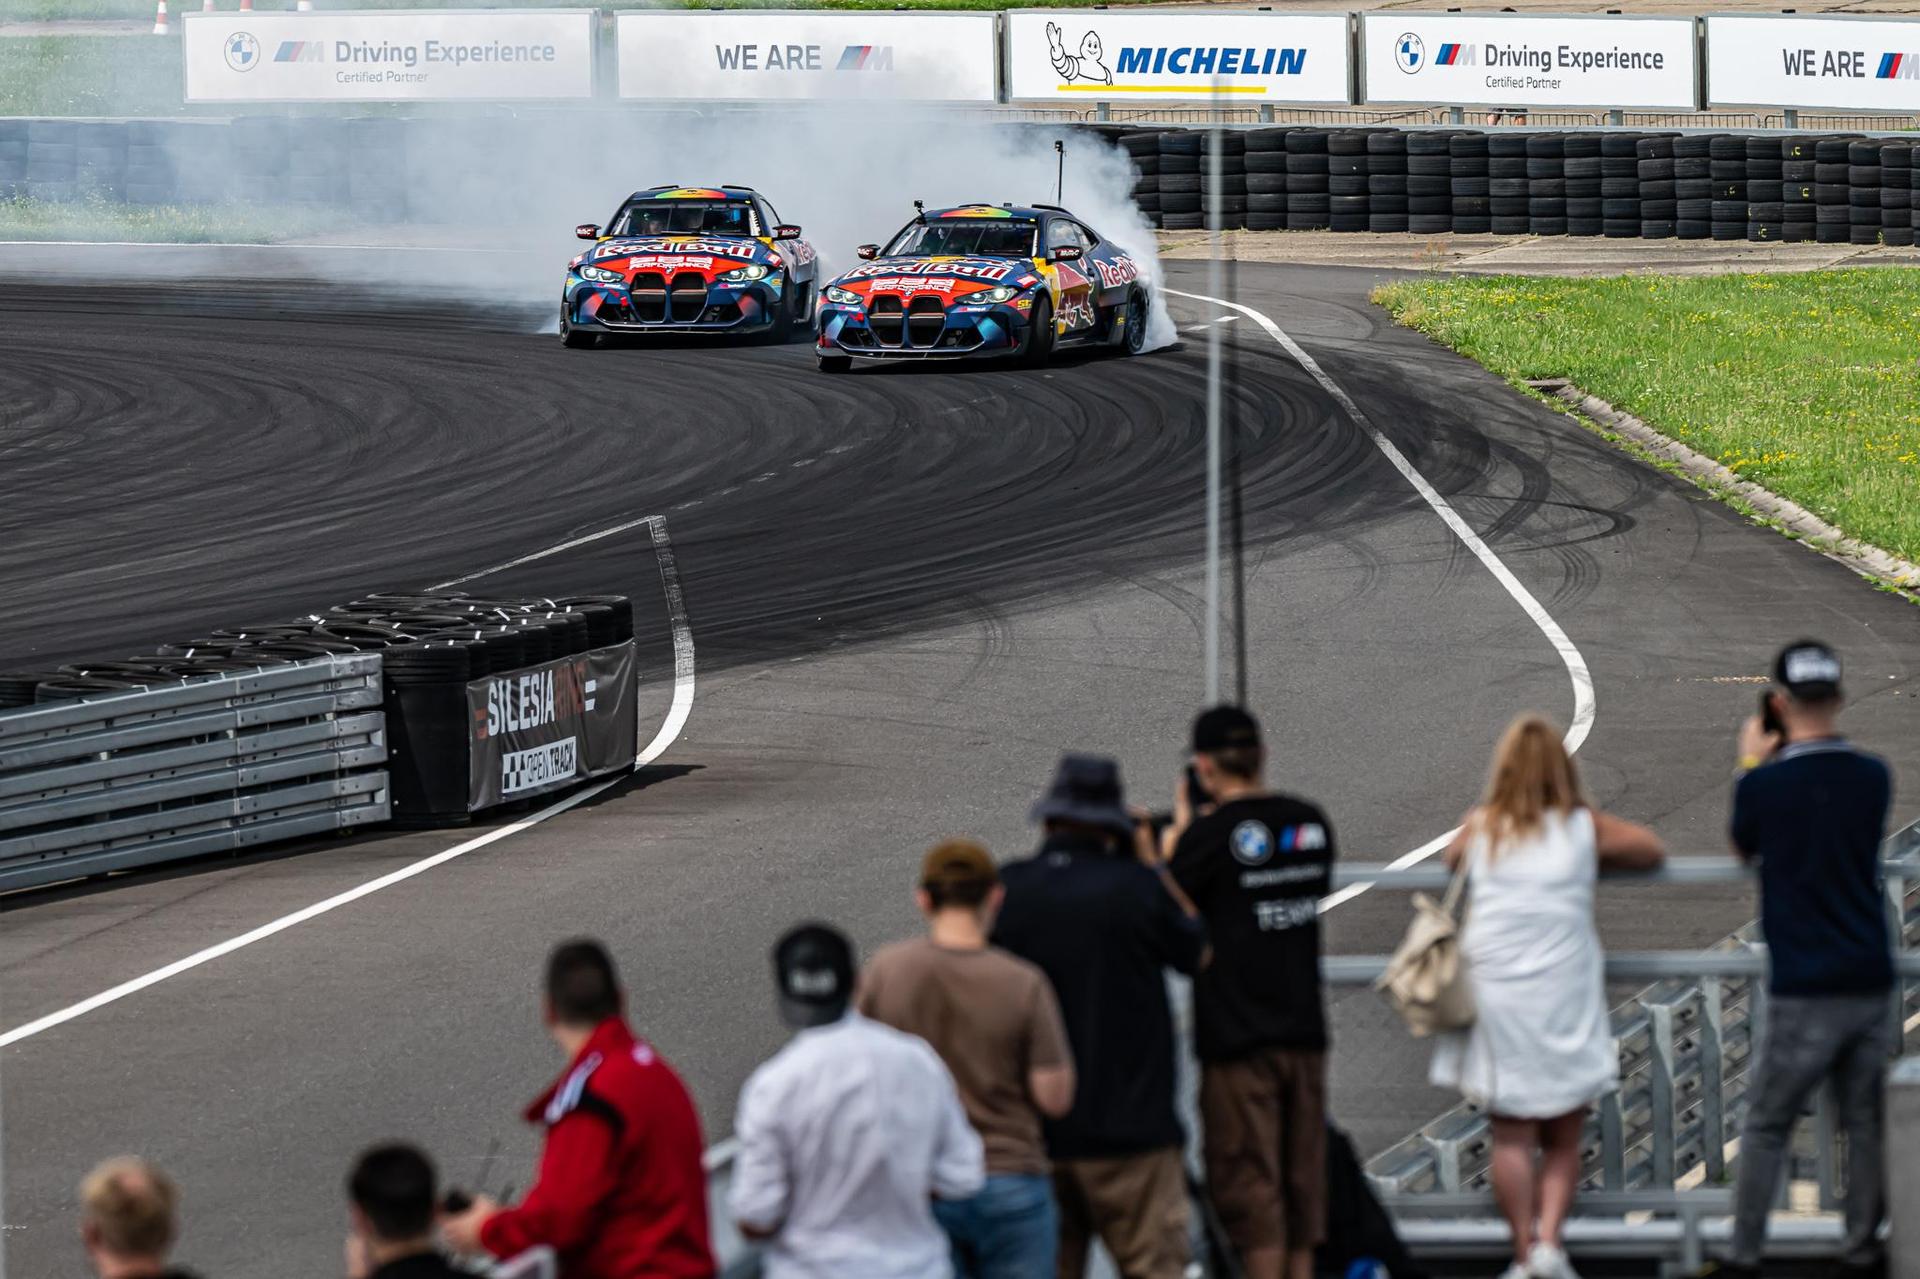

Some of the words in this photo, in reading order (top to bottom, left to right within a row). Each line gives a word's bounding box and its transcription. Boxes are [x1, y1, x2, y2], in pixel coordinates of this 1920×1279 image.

[335, 40, 417, 67] Driving
[424, 40, 556, 67] Experience
[715, 45, 758, 70] WE
[765, 44, 823, 70] ARE
[1116, 47, 1307, 75] MICHELIN
[1485, 44, 1552, 72] Driving
[1558, 45, 1664, 72] Experience
[1783, 48, 1816, 76] WE
[1821, 50, 1865, 78] ARE
[336, 71, 383, 83] Certified
[386, 71, 429, 83] Partner
[1486, 75, 1524, 89] Certified
[1526, 75, 1562, 89] Partner
[594, 242, 673, 259] Red
[675, 243, 756, 259] Bull
[843, 262, 924, 280] Red
[923, 262, 1011, 281] Bull
[527, 750, 549, 783] OPEN
[549, 741, 574, 777] TRACK
